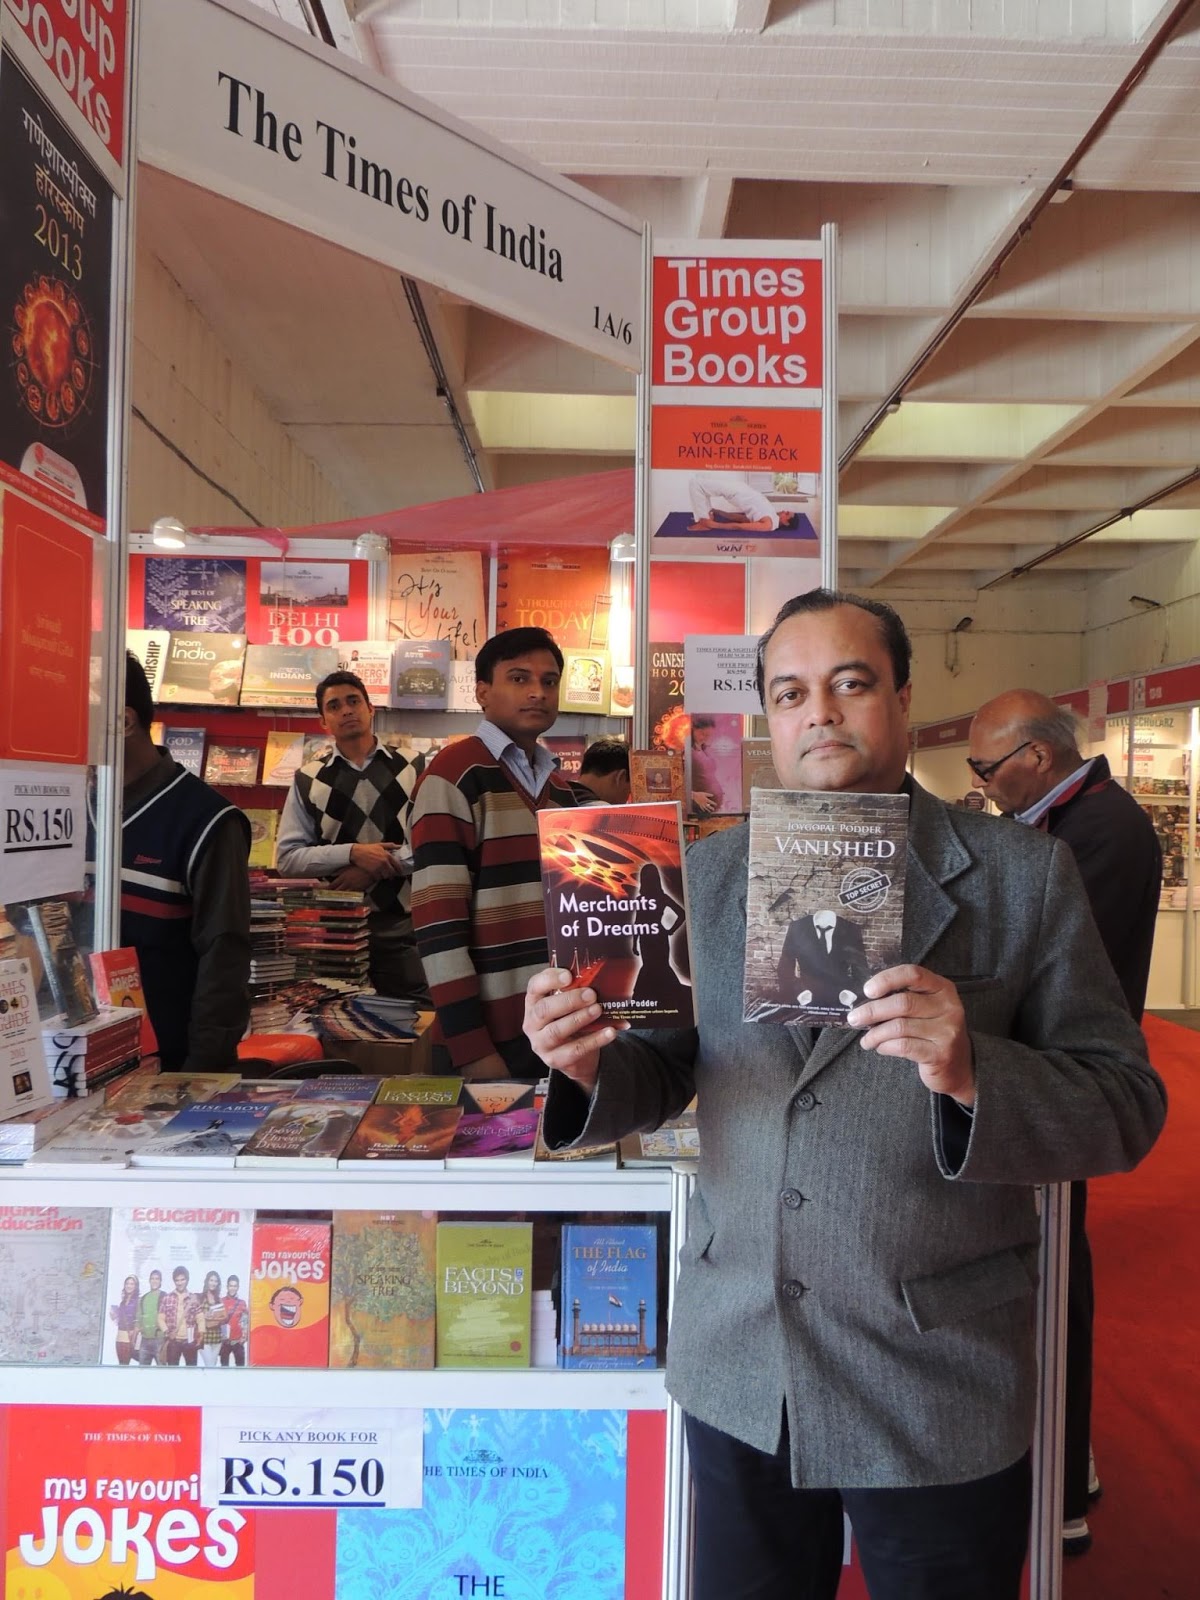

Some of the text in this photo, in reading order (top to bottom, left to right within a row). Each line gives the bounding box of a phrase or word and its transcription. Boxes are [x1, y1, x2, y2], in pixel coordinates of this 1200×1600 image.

[218, 71, 564, 282] The Times of India
[34, 203, 82, 280] 2013
[668, 260, 805, 298] Times
[593, 305, 633, 346] 1A/6
[664, 299, 806, 344] Group
[664, 344, 807, 384] Books
[692, 432, 783, 446] YOGA FOR A
[678, 446, 798, 461] PAIN-FREE BACK
[171, 600, 222, 610] SPEAKING
[184, 616, 209, 625] TREE
[268, 612, 339, 628] DELHI
[516, 609, 592, 630] TODAY
[174, 638, 201, 647] Team
[268, 627, 339, 647] 100
[172, 646, 216, 660] India
[270, 672, 312, 680] INDIANS
[166, 736, 193, 746] GOD
[5, 808, 73, 843] RS.150
[775, 836, 896, 858] VANISHED
[845, 880, 883, 900] TOP SECRET
[559, 893, 657, 913] Merchants
[561, 917, 660, 937] of Dreams
[0, 1216, 83, 1231] ducation
[132, 1207, 240, 1225] Education
[573, 1247, 646, 1259] THE FLAG
[444, 1267, 512, 1282] FACTS
[587, 1260, 628, 1275] of India
[444, 1280, 524, 1295] BEYOND
[83, 1432, 182, 1442] THE TIMES OF INDIA
[240, 1431, 377, 1442] PICK ANY BOOK FOR
[219, 1457, 385, 1497] RS.150
[447, 1466, 486, 1477] TIMES
[490, 1467, 507, 1478] OF
[512, 1467, 548, 1479] INDIA
[454, 1574, 505, 1597] THE
